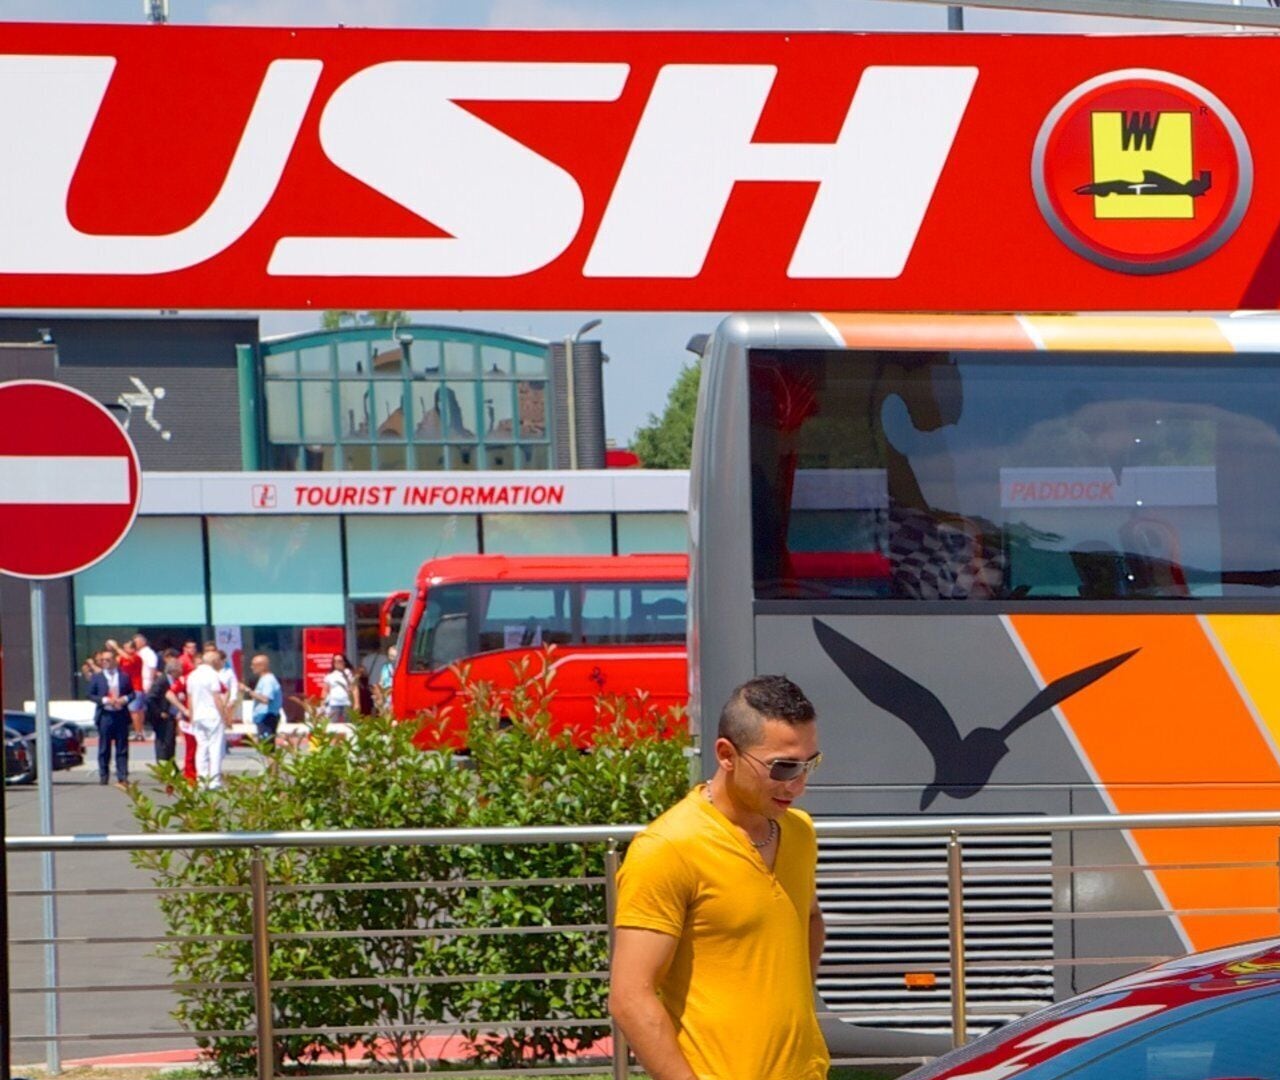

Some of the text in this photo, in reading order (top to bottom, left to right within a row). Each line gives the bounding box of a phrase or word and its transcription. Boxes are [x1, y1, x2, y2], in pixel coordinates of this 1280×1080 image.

[294, 484, 565, 506] TOURIST INFORMATION
[1010, 480, 1115, 502] PADDOCK
